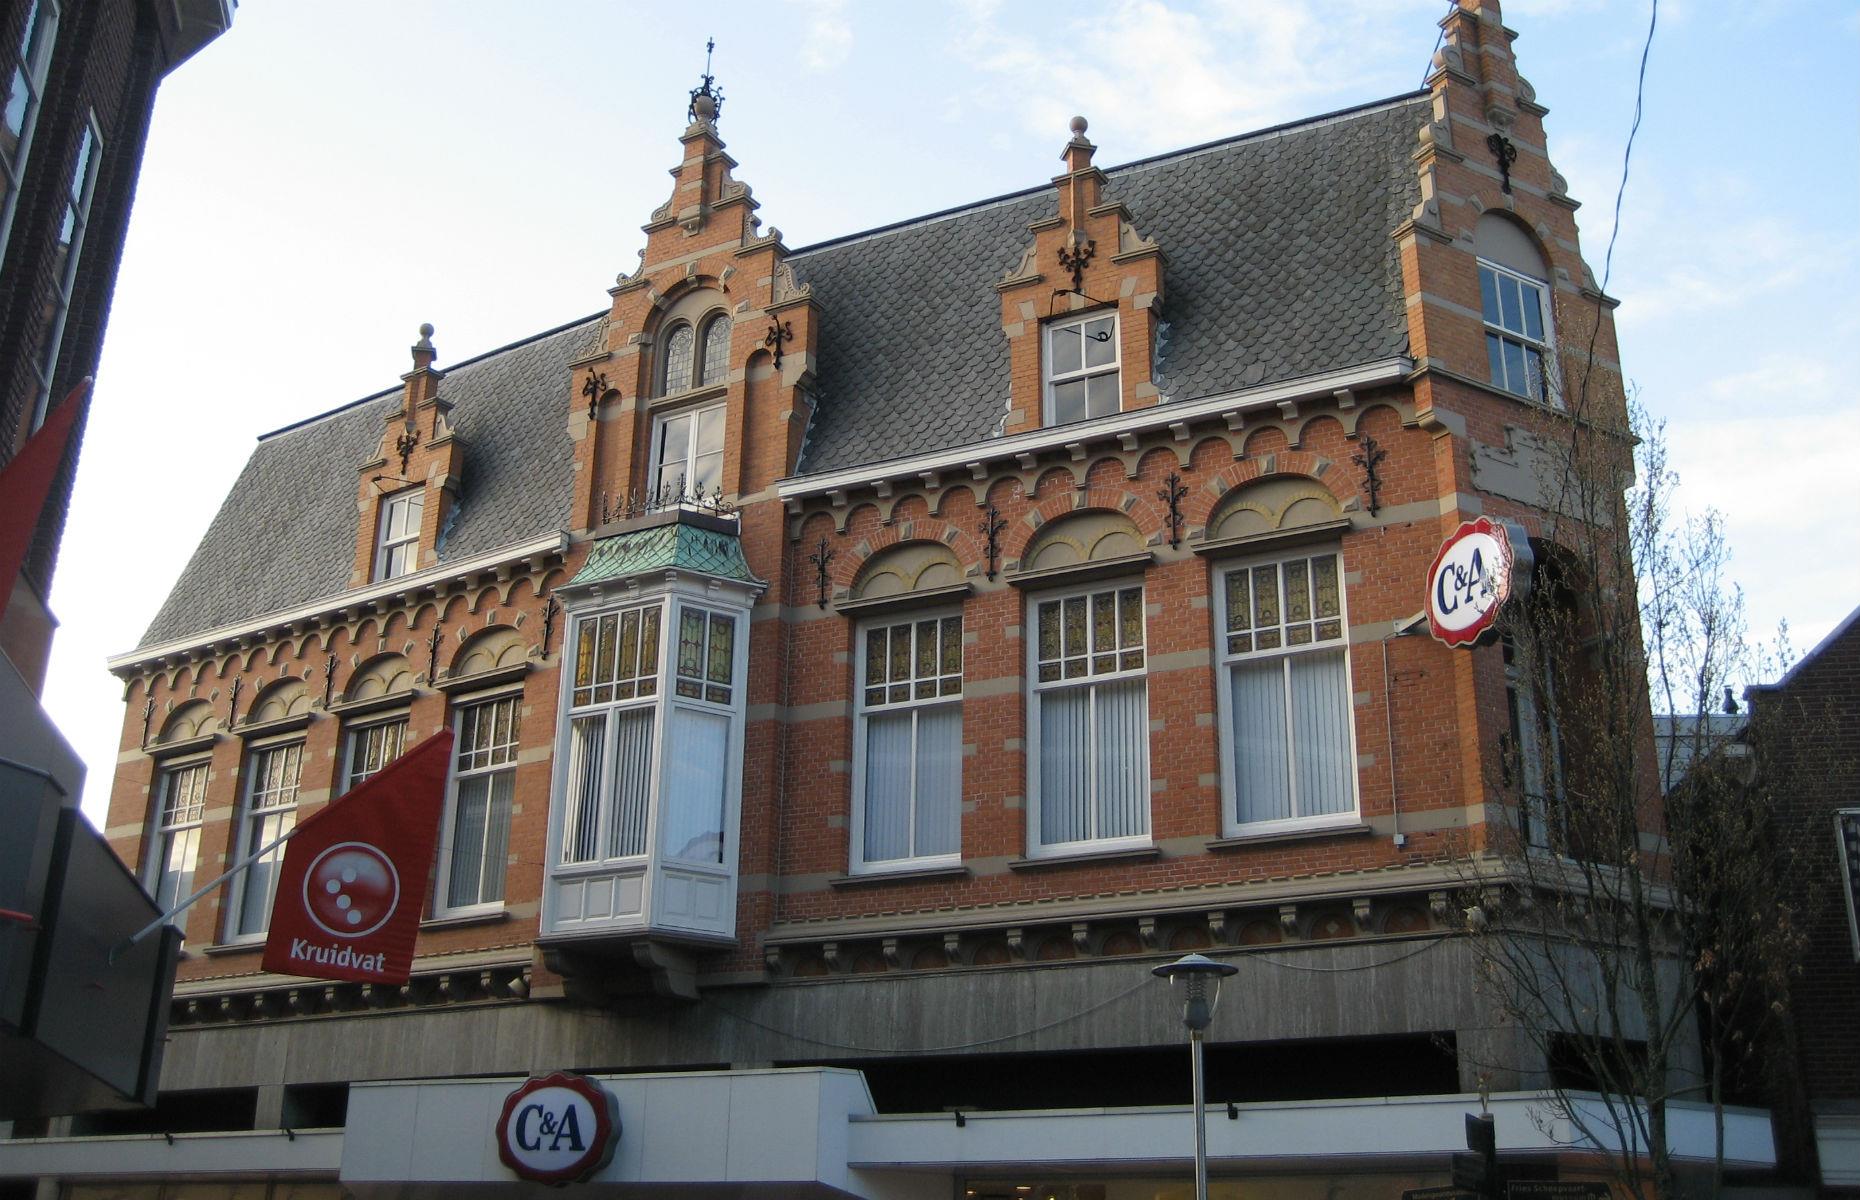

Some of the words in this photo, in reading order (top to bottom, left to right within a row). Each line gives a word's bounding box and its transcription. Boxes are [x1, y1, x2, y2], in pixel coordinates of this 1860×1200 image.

[1437, 547, 1489, 616] C&A
[290, 937, 386, 972] Kruidvat
[515, 1104, 586, 1152] C&A
